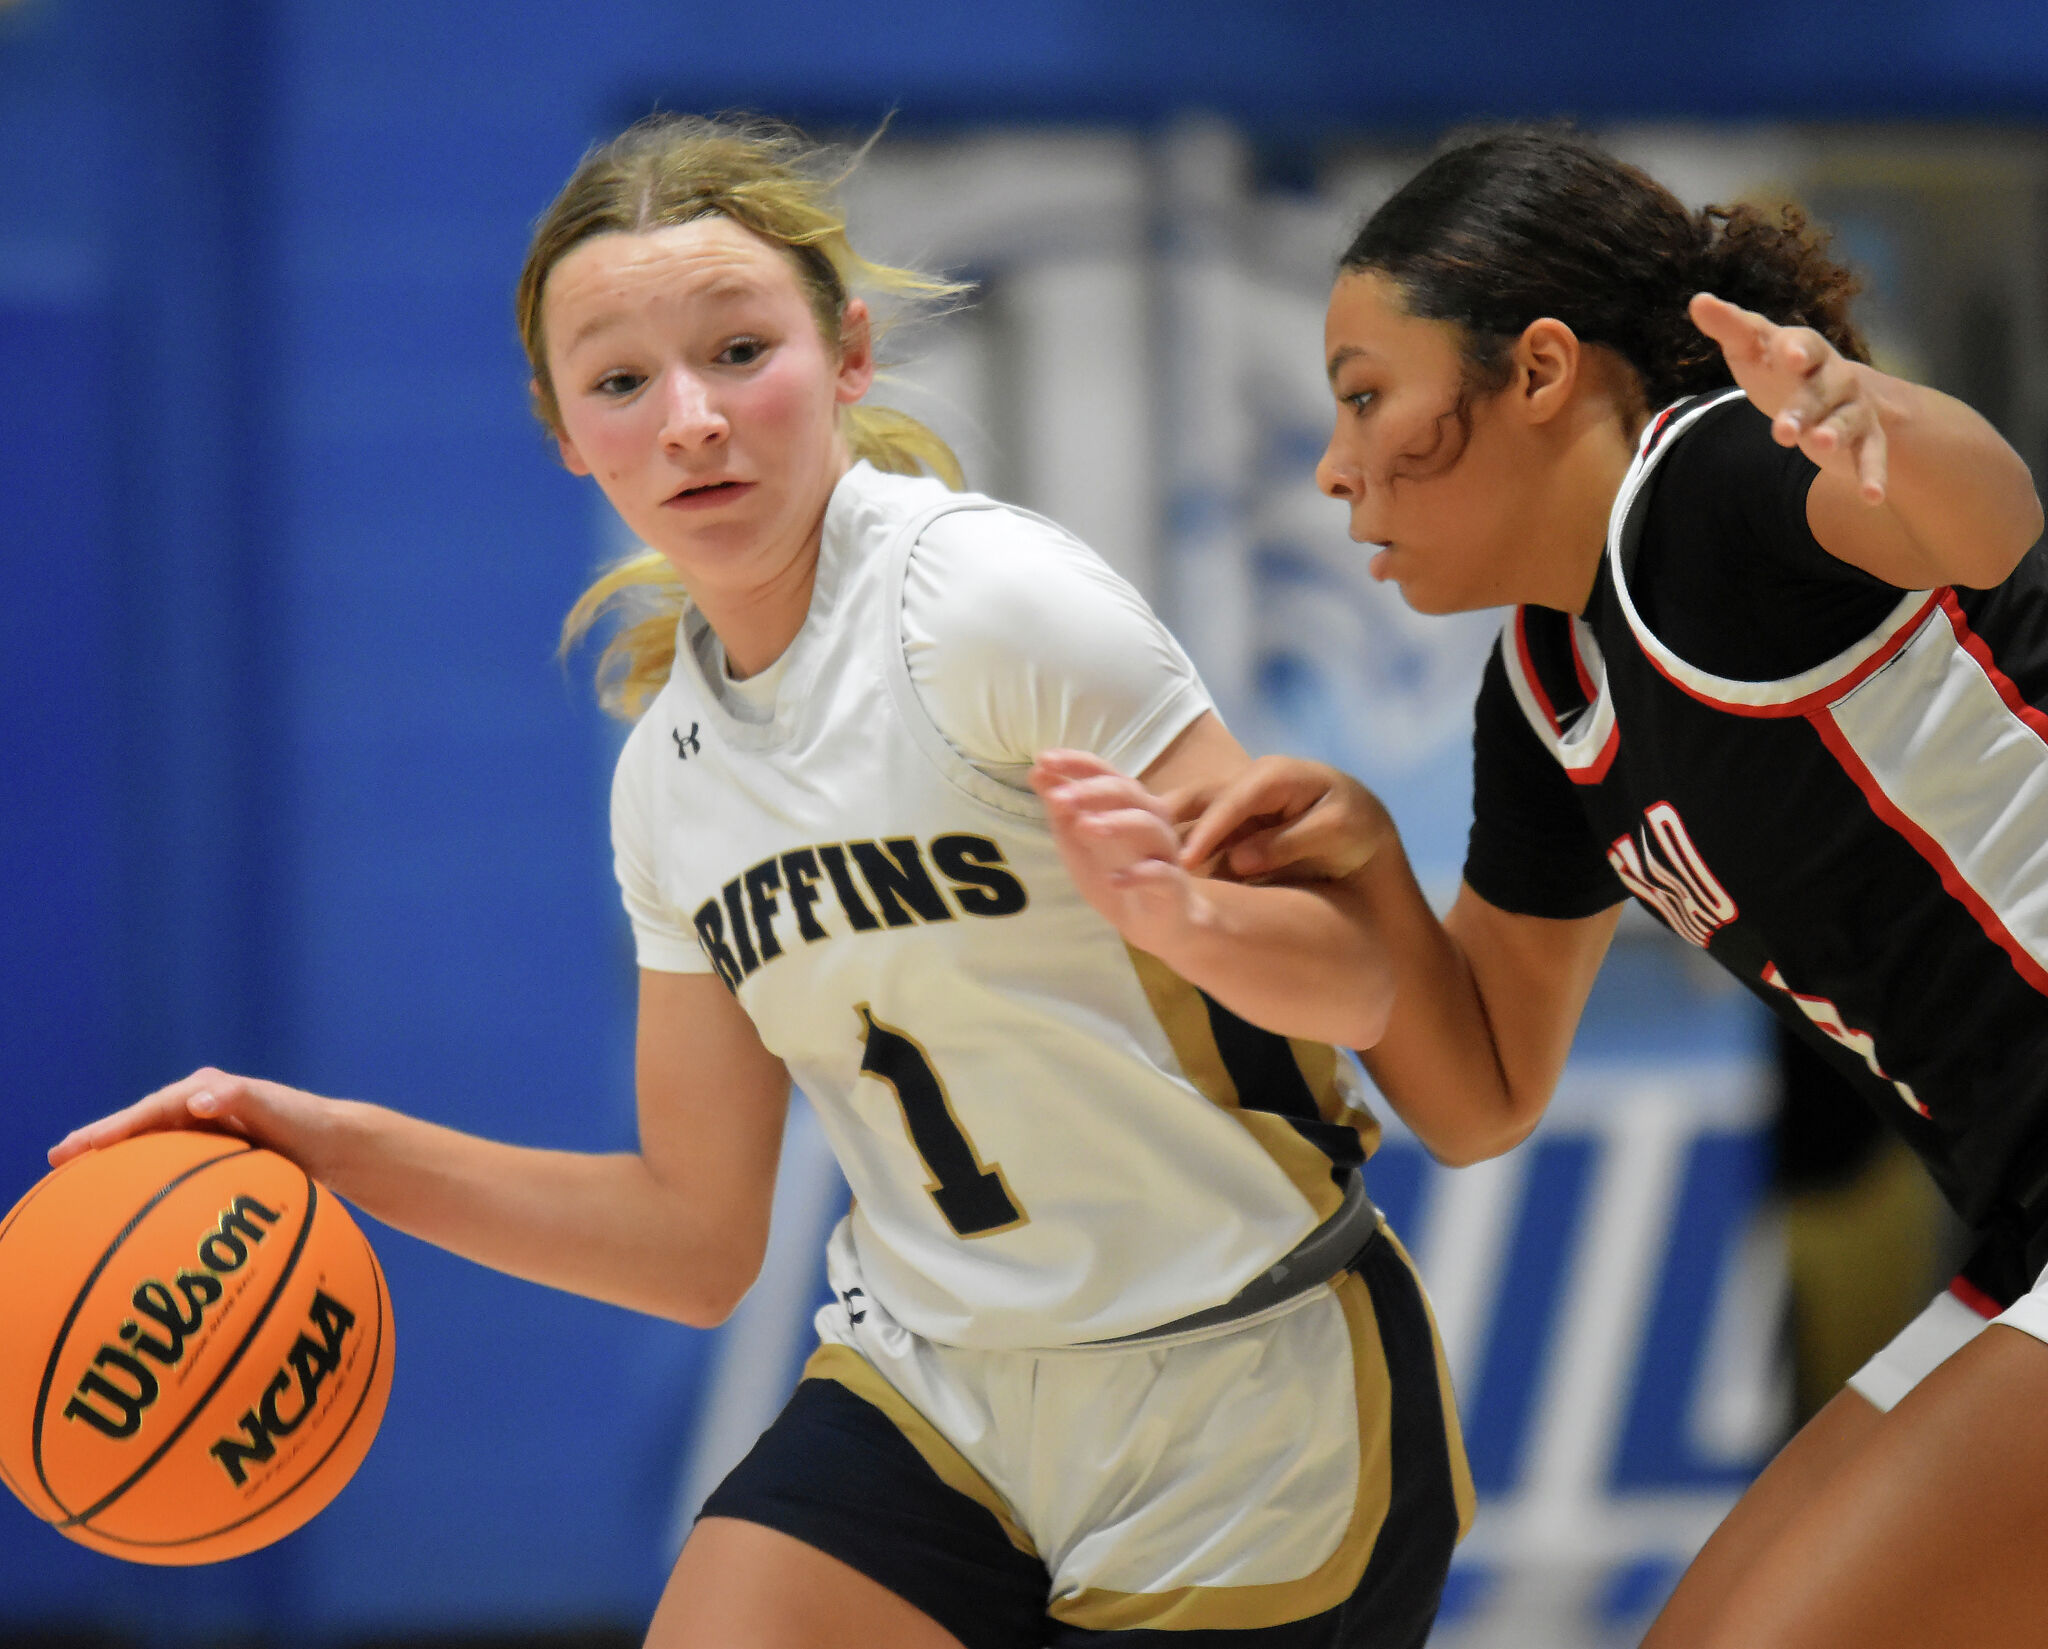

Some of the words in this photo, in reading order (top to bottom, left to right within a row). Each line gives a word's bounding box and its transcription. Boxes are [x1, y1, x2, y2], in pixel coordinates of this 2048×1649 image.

[853, 1001, 1030, 1240] 1
[62, 1194, 282, 1440] Wilson
[209, 1289, 356, 1487] NCAA
